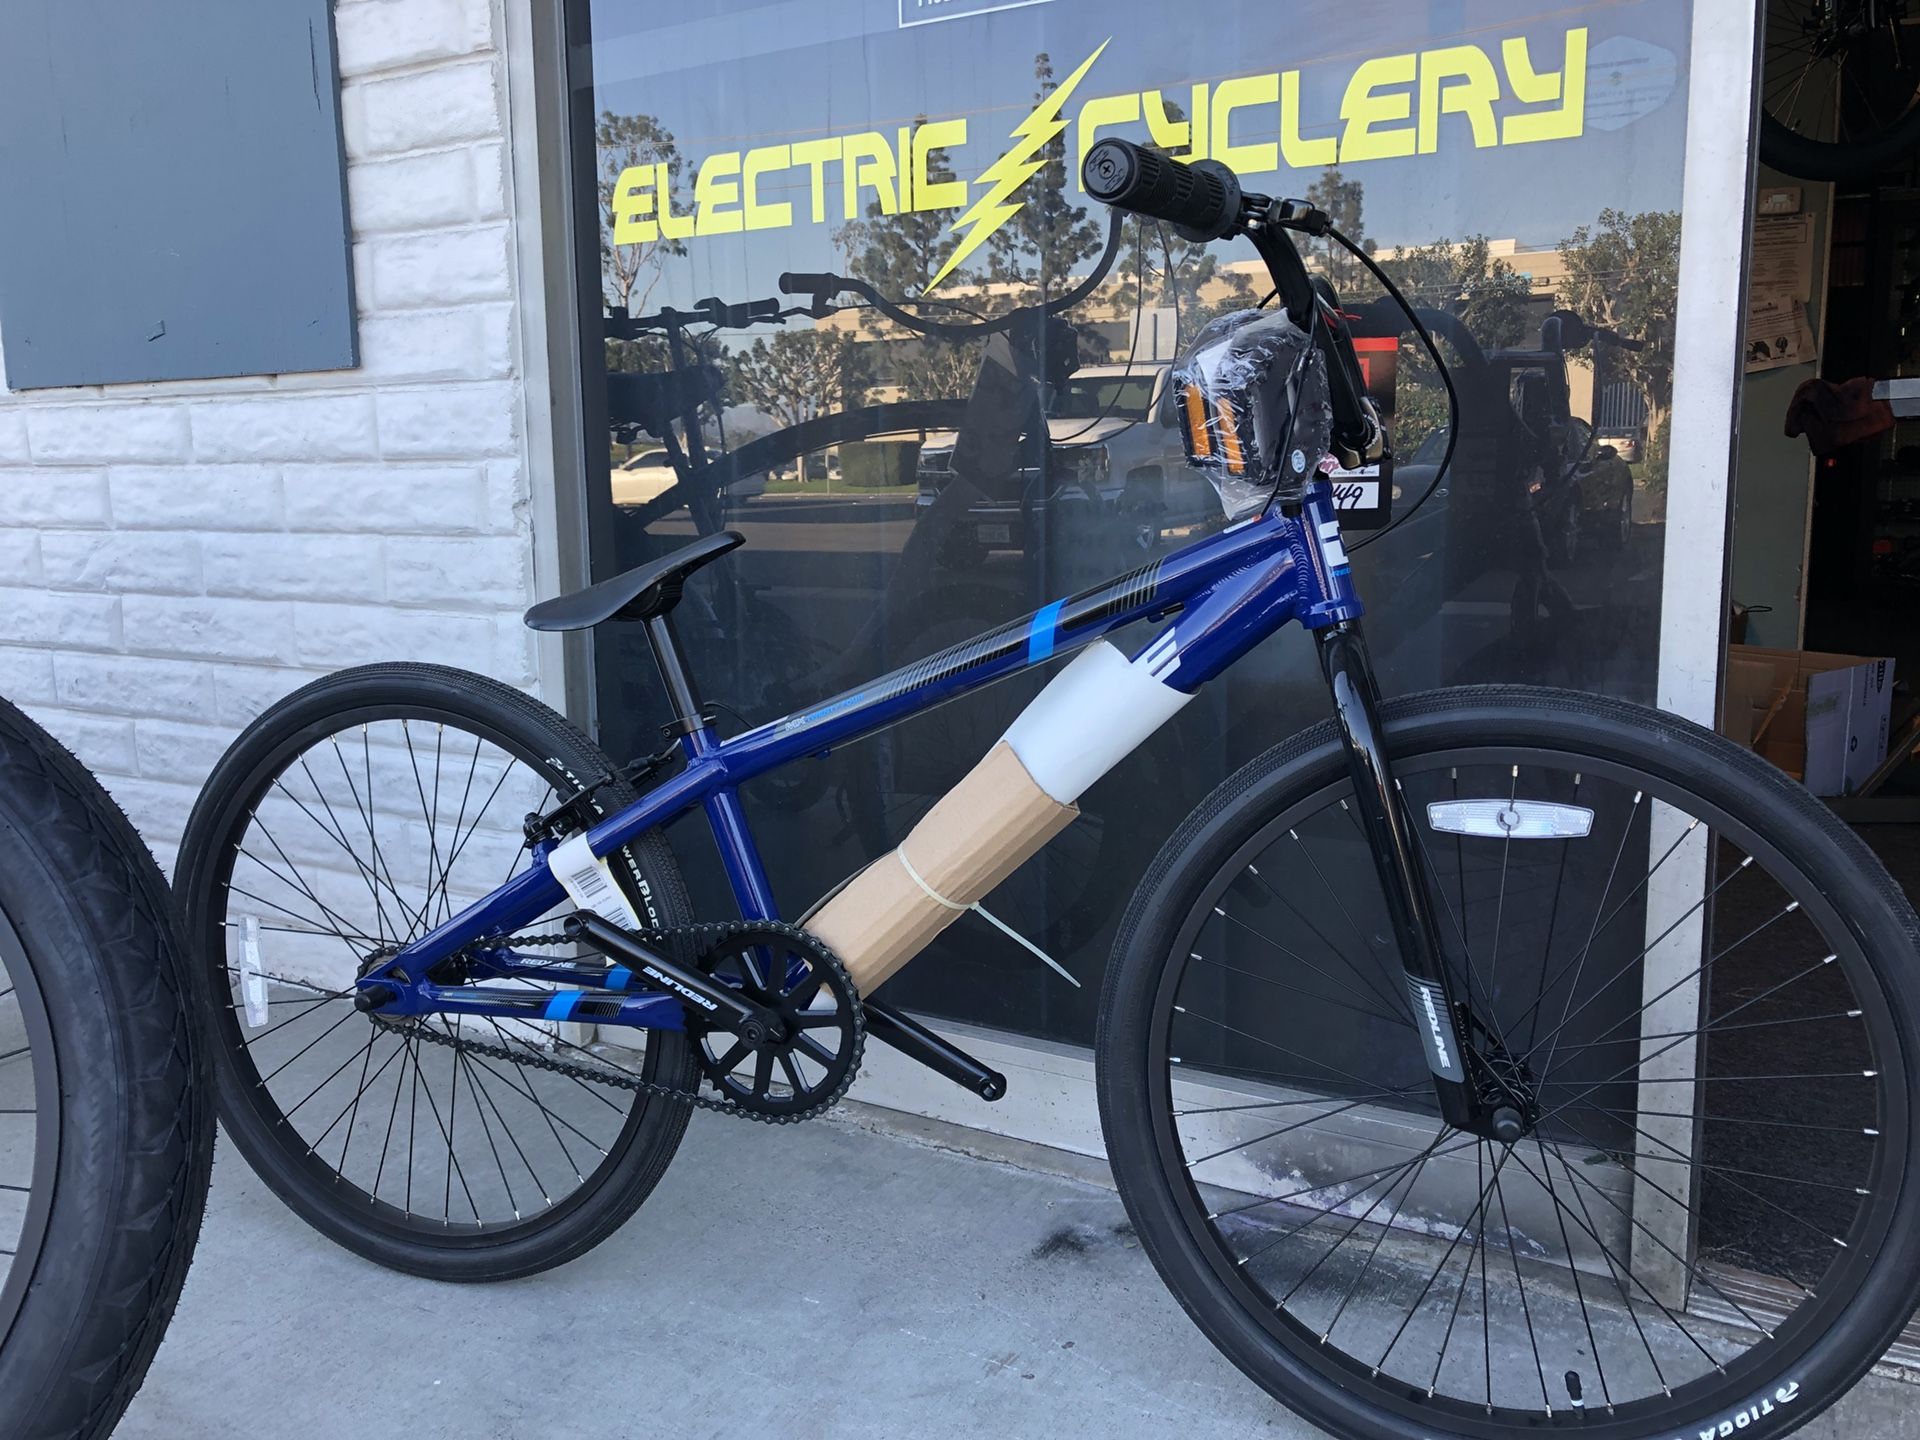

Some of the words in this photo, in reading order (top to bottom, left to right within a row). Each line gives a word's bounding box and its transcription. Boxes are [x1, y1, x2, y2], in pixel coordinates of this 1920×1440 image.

[612, 118, 968, 246] ELECTRIC
[1077, 27, 1588, 193] CYCLERY
[642, 965, 718, 1012] REDLINE
[1420, 986, 1451, 1068] REDLINE
[1698, 1398, 1775, 1440] TIOGA
